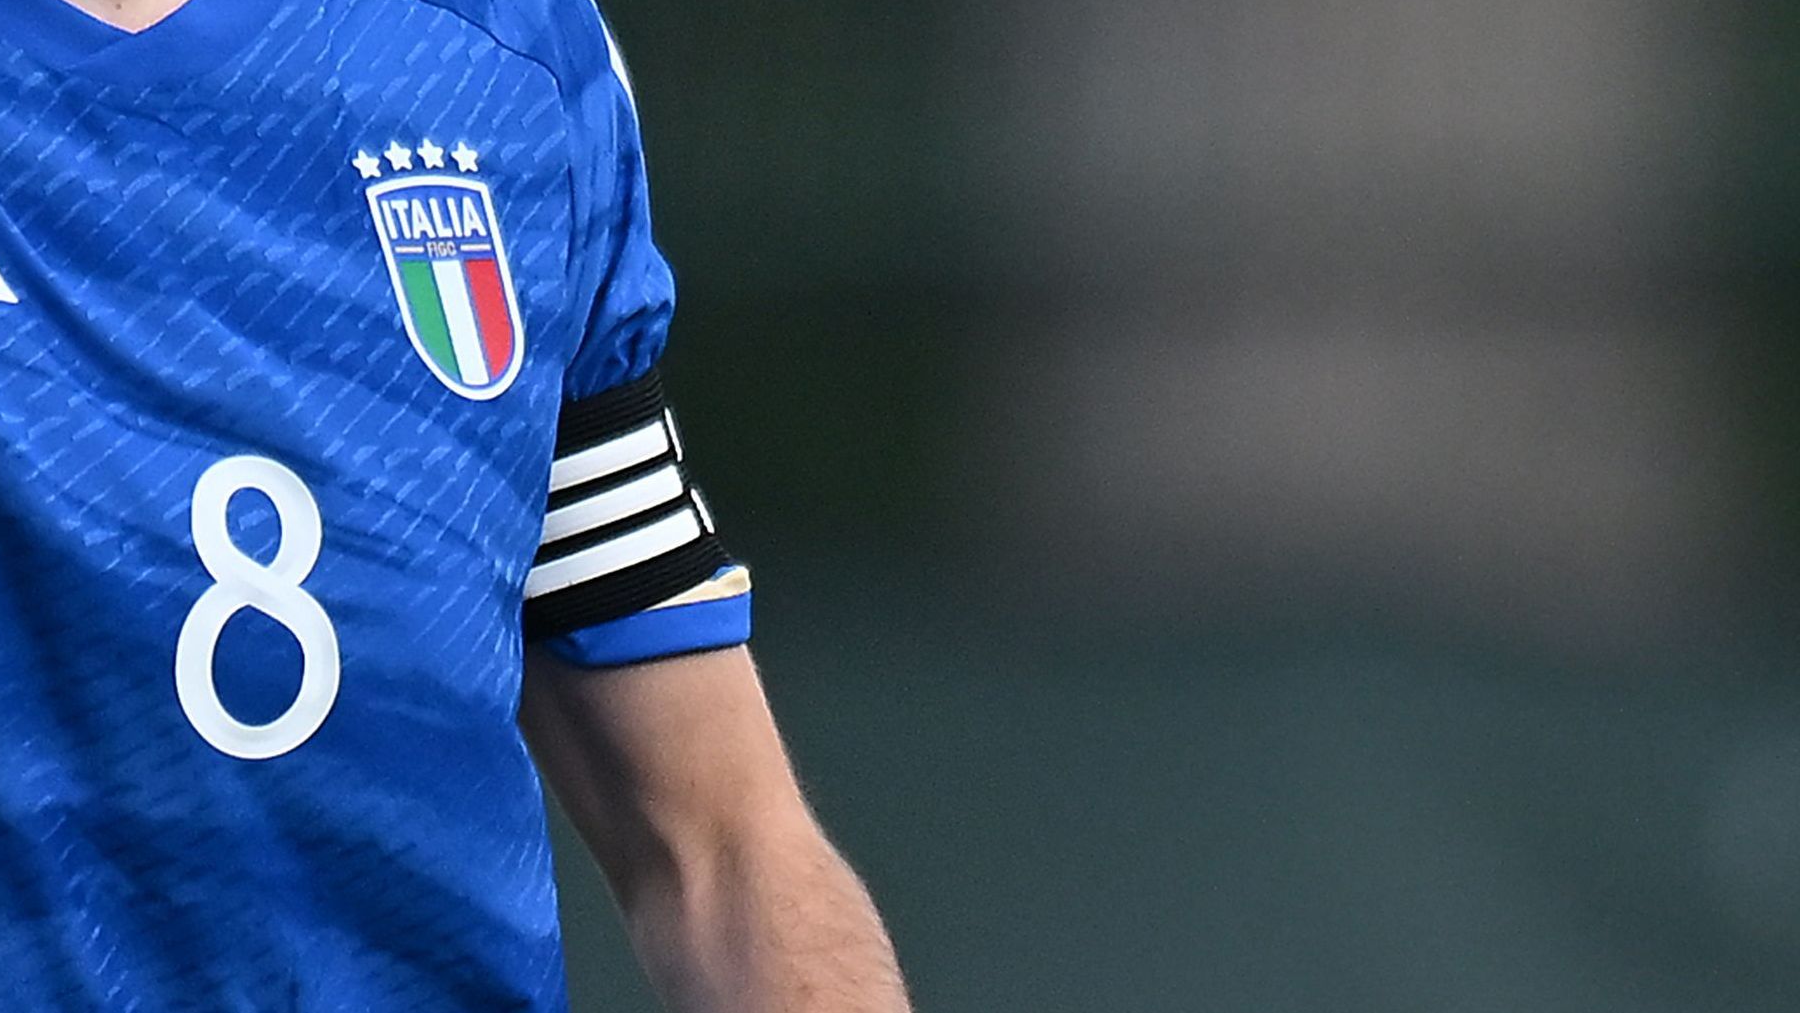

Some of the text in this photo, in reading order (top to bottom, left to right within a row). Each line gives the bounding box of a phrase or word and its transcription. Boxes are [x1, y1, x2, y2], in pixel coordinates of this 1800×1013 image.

[381, 196, 487, 239] ITALIA
[426, 240, 457, 258] FIGC
[175, 454, 340, 760] 8
